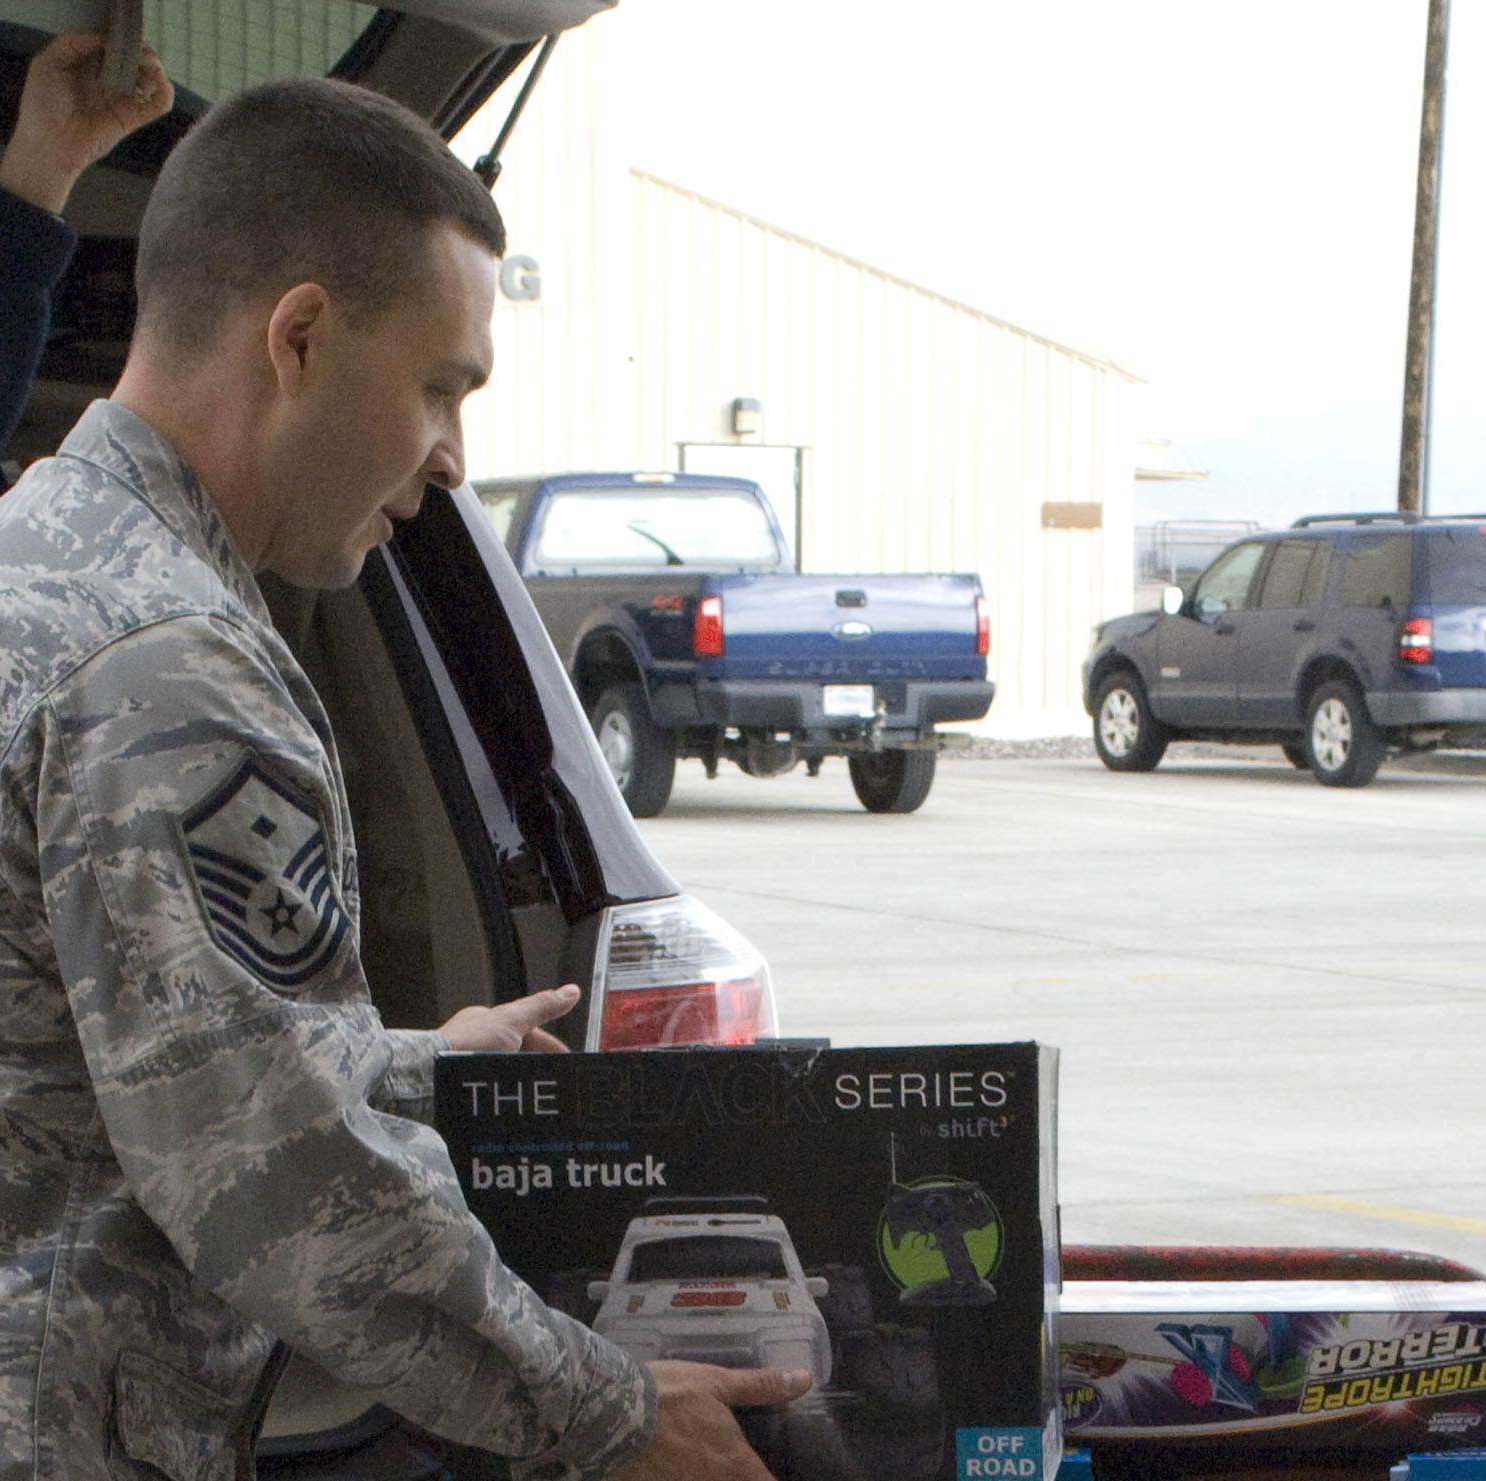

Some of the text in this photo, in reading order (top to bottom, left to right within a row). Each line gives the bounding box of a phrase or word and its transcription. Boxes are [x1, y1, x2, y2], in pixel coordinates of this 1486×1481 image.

[463, 1062, 1008, 1128] THE BLACK SERIES
[472, 1154, 667, 1196] baja truck
[1310, 1324, 1486, 1375] TERROR
[977, 1435, 1024, 1453] OFF
[966, 1458, 1036, 1477] ROAD
